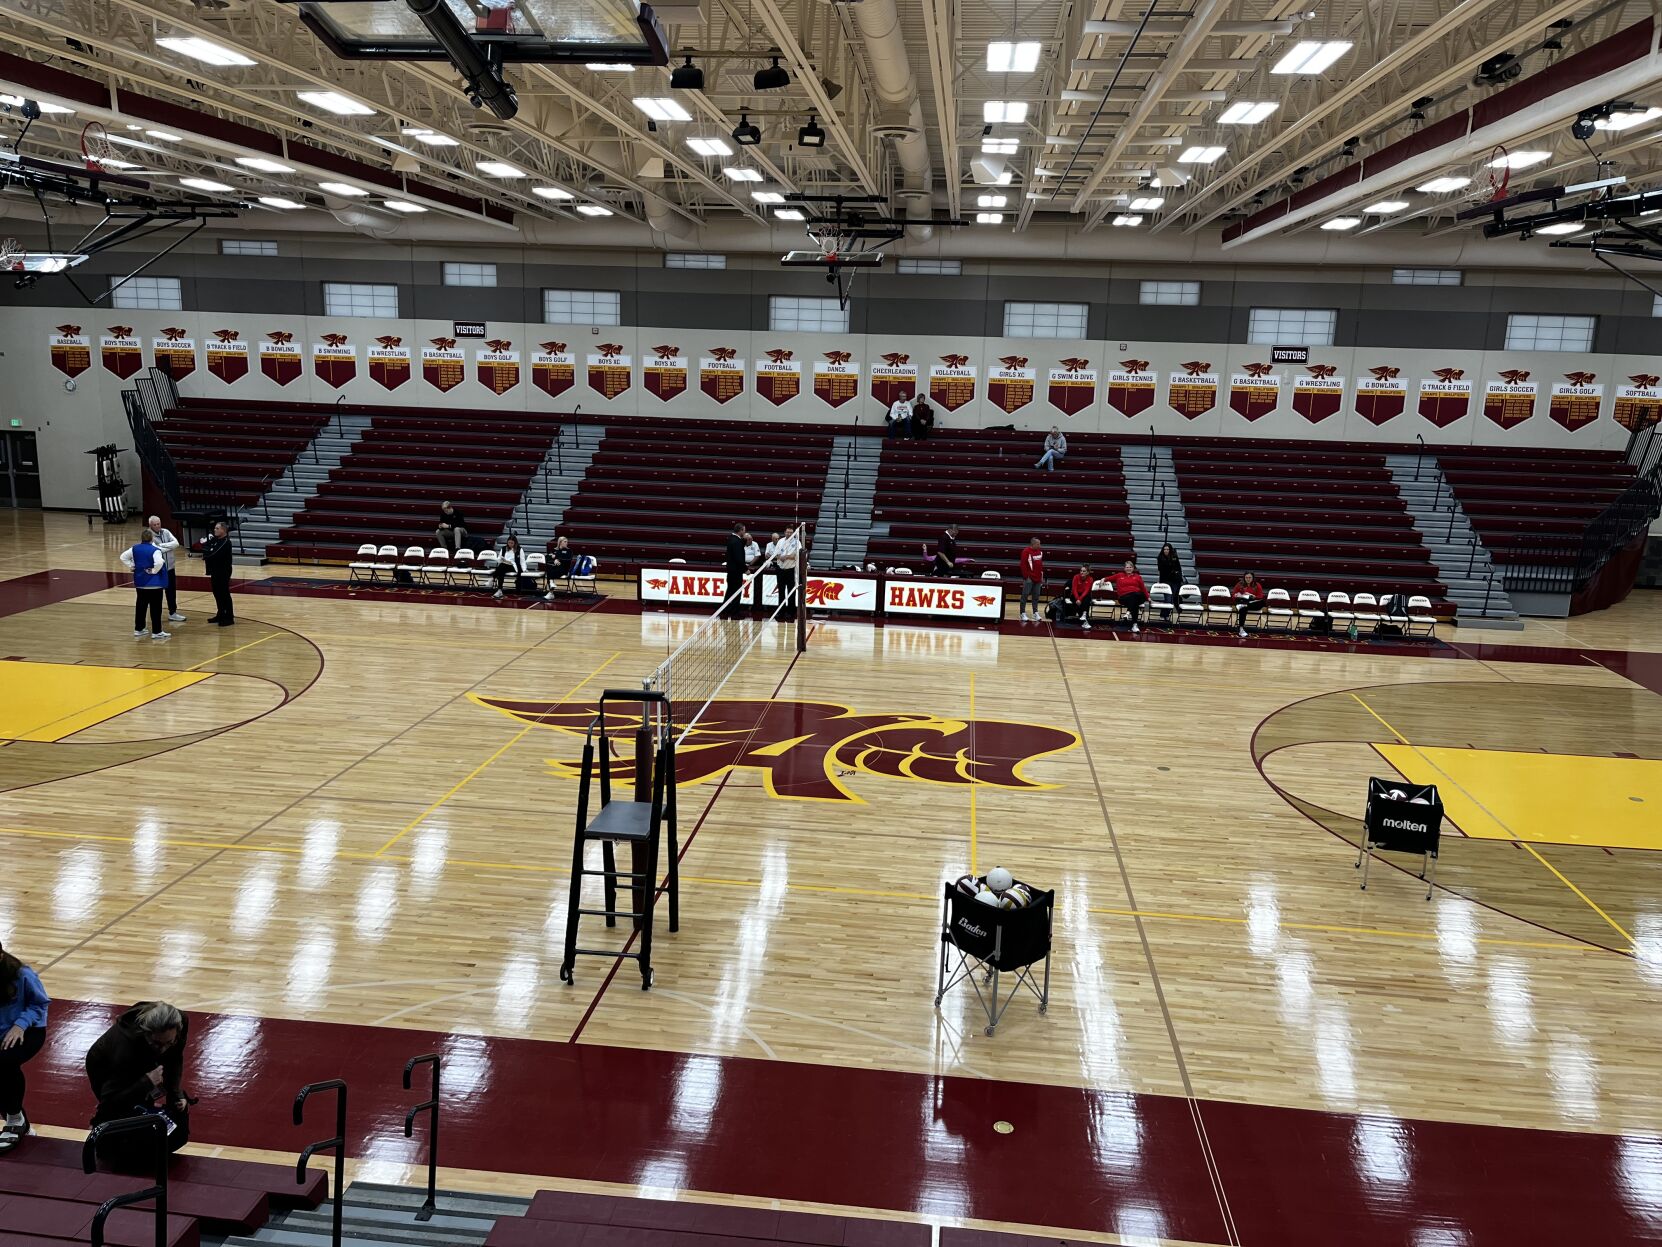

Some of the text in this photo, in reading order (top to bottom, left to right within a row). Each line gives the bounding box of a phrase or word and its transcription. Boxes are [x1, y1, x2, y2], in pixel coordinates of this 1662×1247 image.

[456, 325, 484, 334] VISITORS
[1274, 350, 1306, 360] VISITORS
[669, 576, 751, 597] ANKEY
[890, 587, 965, 609] HAWKS
[1383, 818, 1427, 832] molten
[958, 917, 987, 937] Baden
